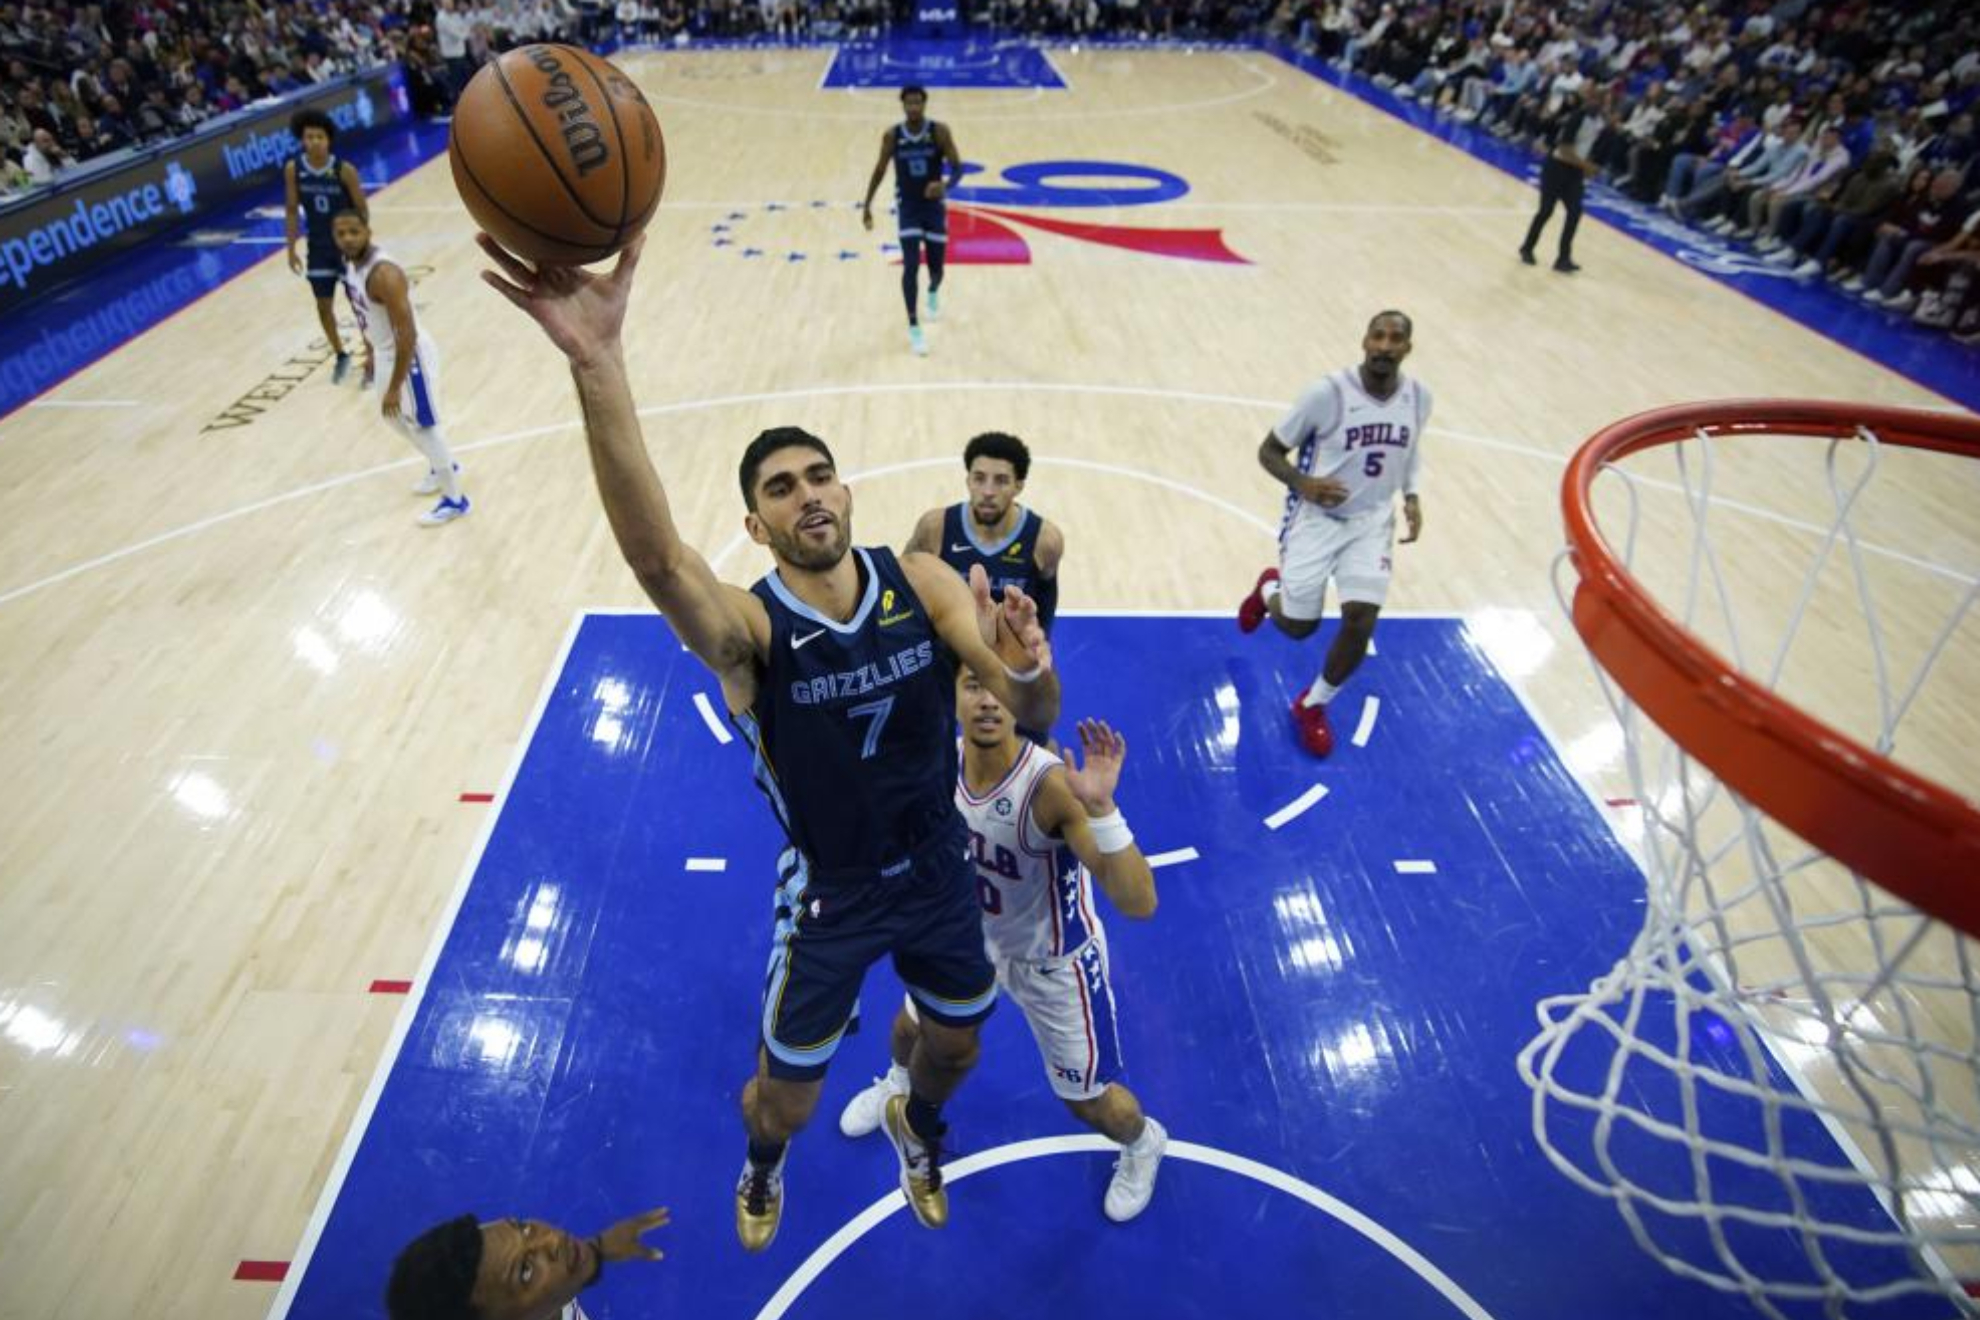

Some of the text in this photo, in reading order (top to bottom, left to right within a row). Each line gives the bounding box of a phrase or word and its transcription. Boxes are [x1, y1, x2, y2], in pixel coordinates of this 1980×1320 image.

[1365, 451, 1386, 477] 5
[790, 640, 933, 704] GRIZZLIES
[847, 694, 896, 761] 7
